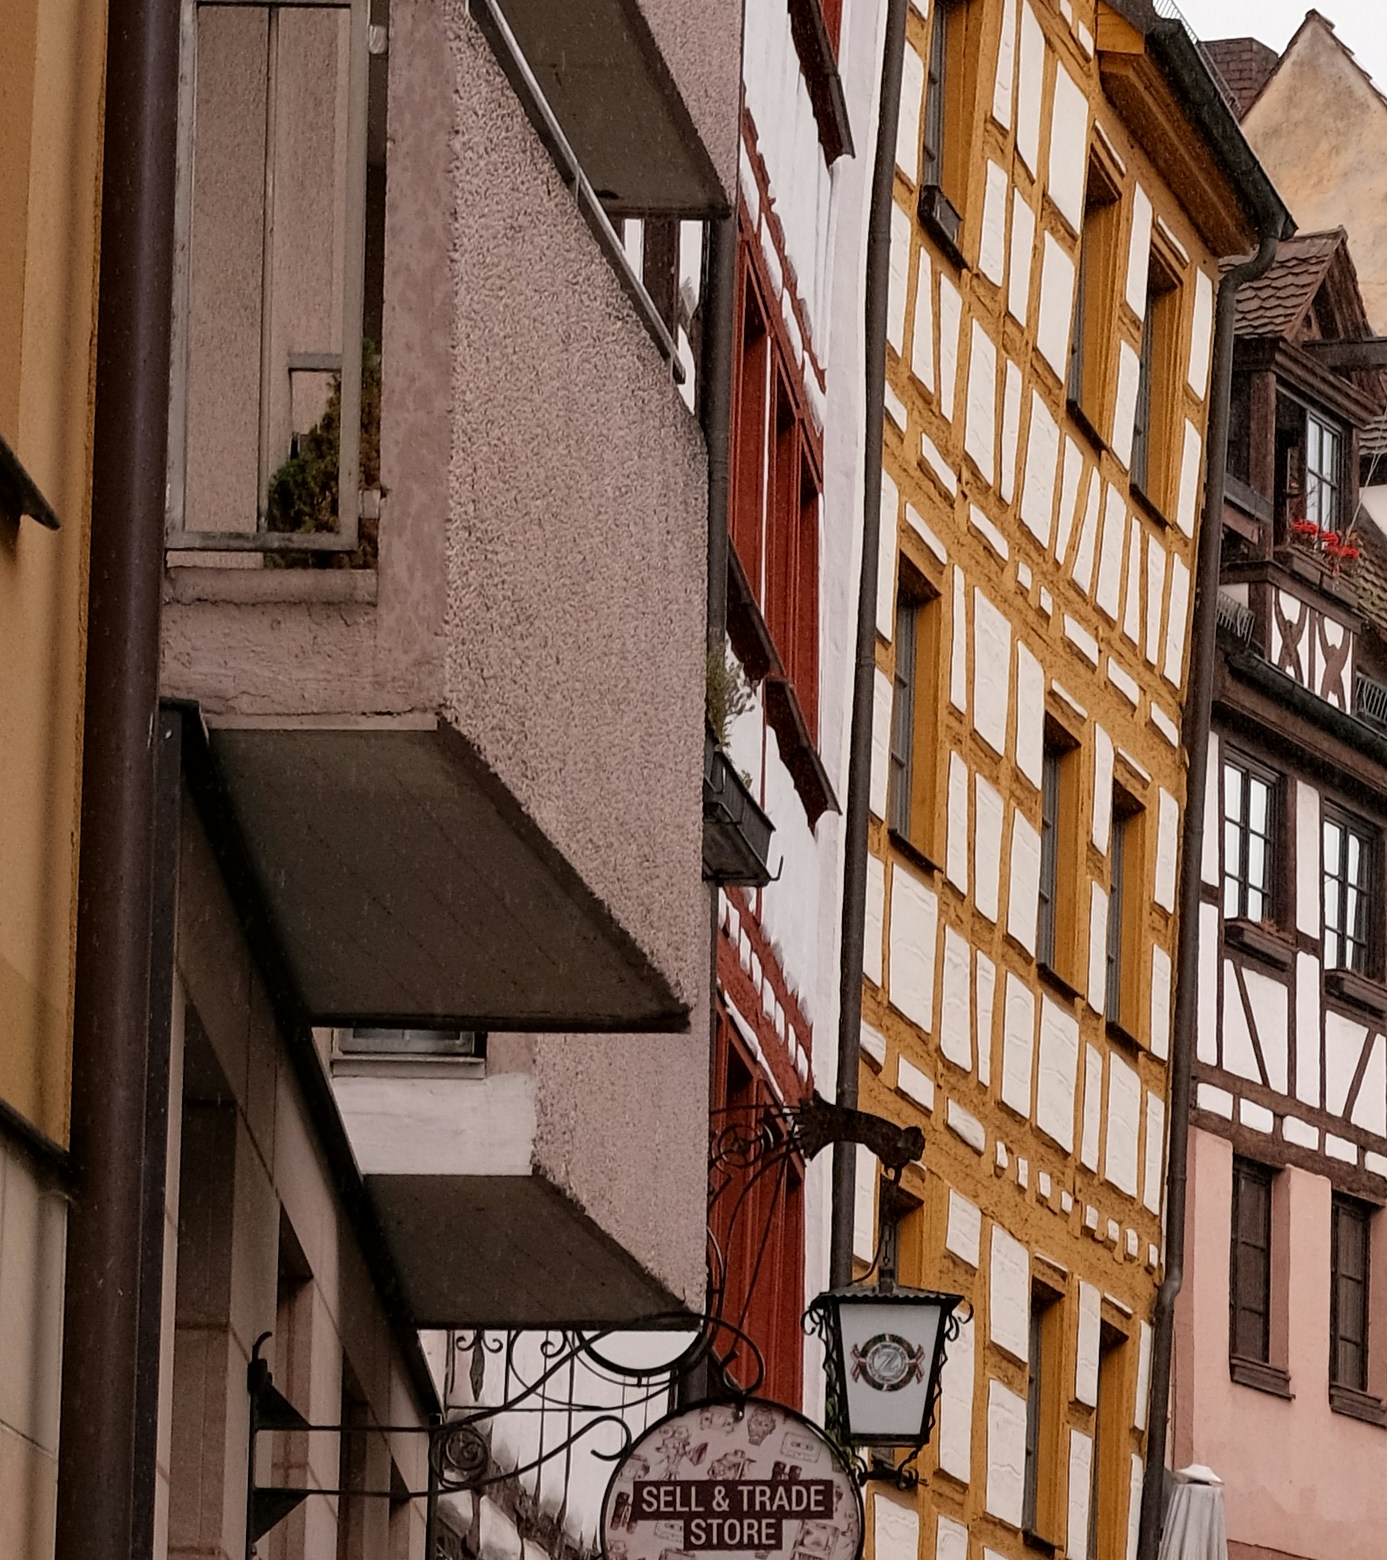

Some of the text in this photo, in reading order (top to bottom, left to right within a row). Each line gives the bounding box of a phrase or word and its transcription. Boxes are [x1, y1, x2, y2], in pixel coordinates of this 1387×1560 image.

[641, 1485, 825, 1513] SELL & TRADE
[690, 1518, 776, 1545] STORE
